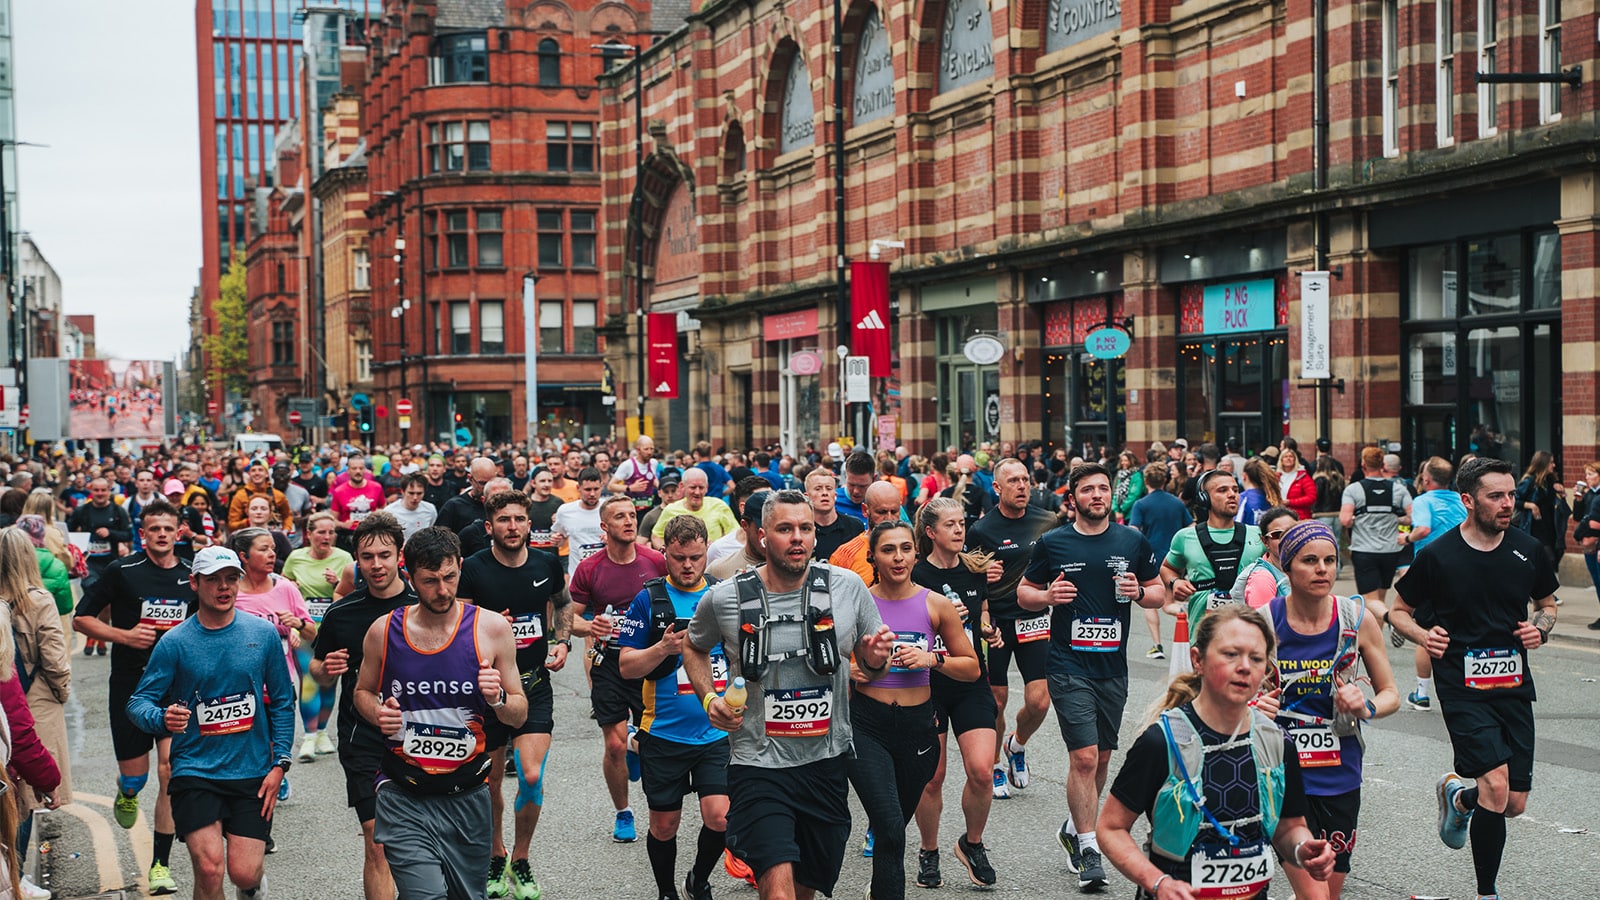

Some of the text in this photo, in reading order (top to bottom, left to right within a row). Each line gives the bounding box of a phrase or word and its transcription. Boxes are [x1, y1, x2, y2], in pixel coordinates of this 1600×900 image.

[967, 10, 982, 31] OF
[950, 43, 994, 80] ENGLAN
[1224, 308, 1249, 329] PUCK
[1306, 304, 1317, 370] Management
[1315, 344, 1324, 370] Suite
[146, 607, 183, 619] 25638
[1019, 619, 1050, 633] 26655
[1077, 626, 1117, 640] 23738
[1471, 660, 1517, 675] 26720
[406, 679, 474, 695] sense
[203, 702, 252, 723] 24753
[772, 701, 830, 720] 25992
[409, 739, 468, 759] 28925
[1201, 859, 1268, 884] 27264
[1221, 886, 1250, 896] REBECCA
